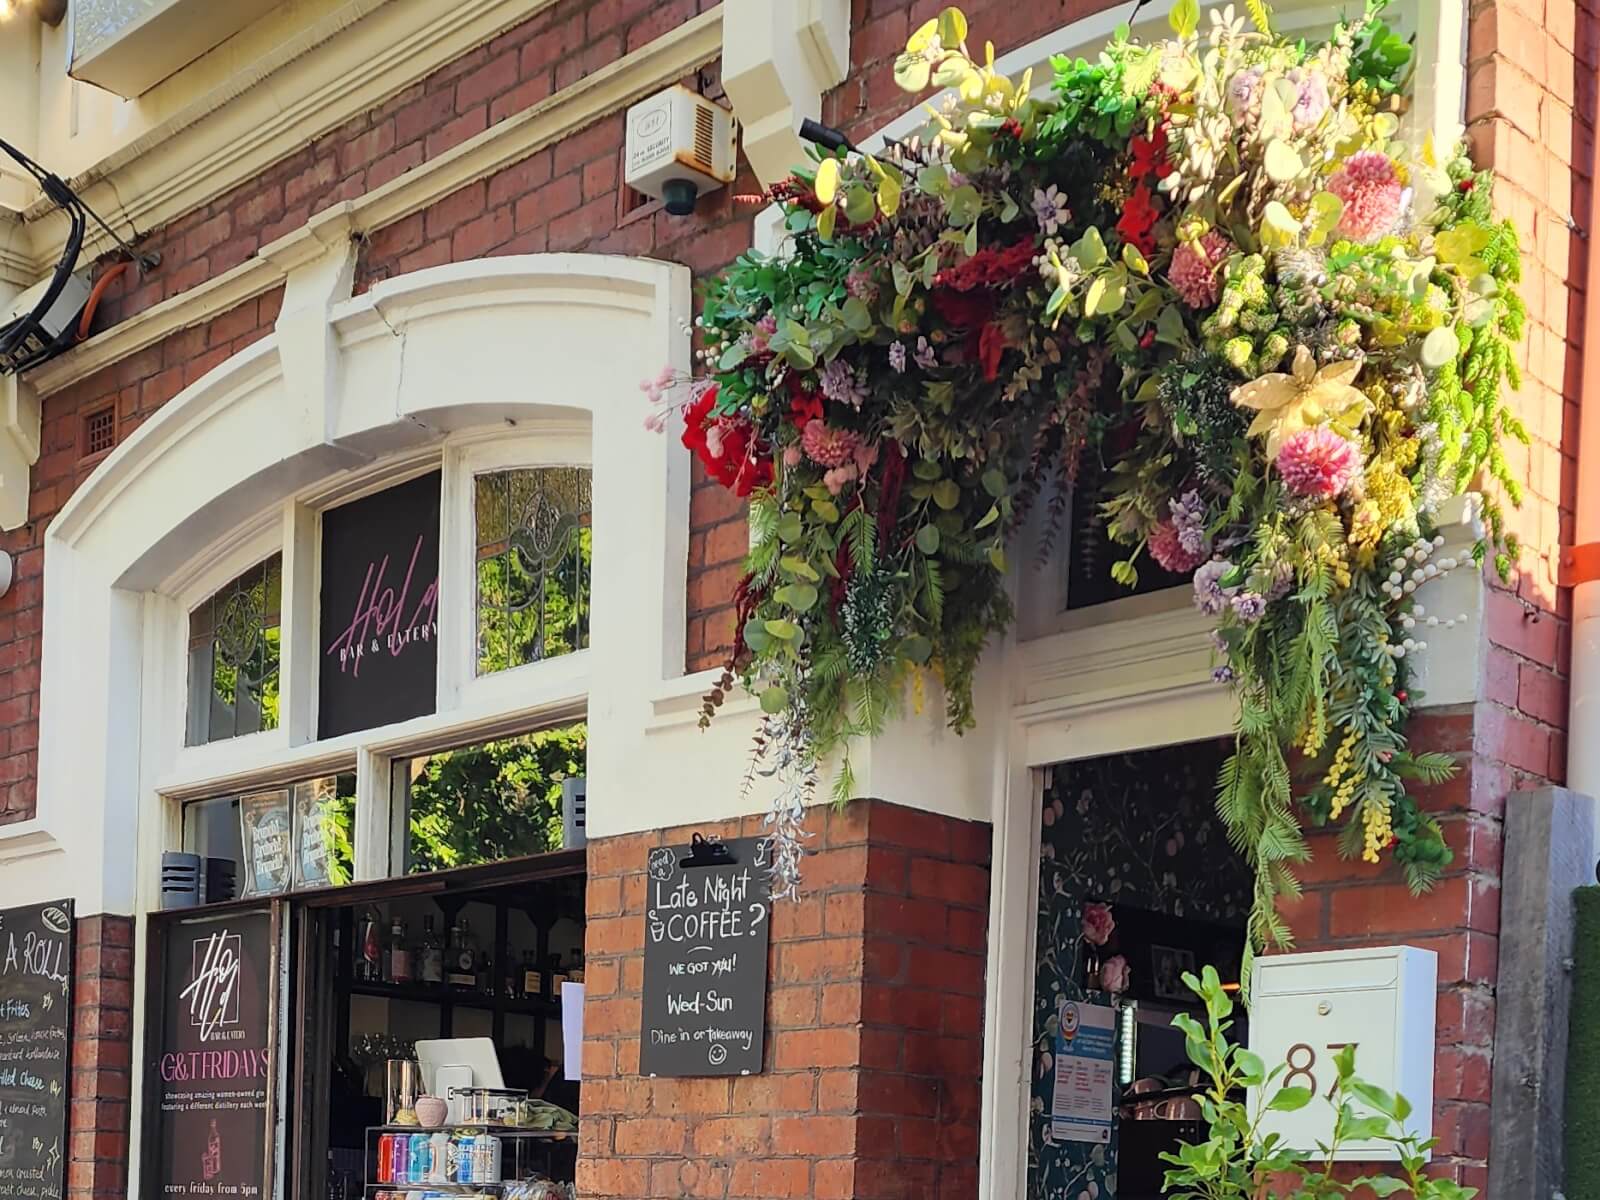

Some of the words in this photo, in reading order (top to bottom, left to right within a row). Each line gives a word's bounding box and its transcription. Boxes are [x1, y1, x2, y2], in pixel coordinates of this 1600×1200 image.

[340, 643, 365, 661] BAR
[371, 639, 380, 652] &
[656, 873, 698, 909] Late
[704, 867, 752, 912] Night
[2, 931, 18, 976] A
[669, 963, 686, 976] WE
[687, 961, 709, 975] GOT
[651, 1028, 677, 1045] Dine
[678, 1026, 691, 1041] in
[693, 1030, 705, 1040] or
[705, 1025, 753, 1051] takeaway
[160, 1051, 200, 1082] G&T
[202, 1048, 269, 1079] FRIDAYS
[1283, 1043, 1360, 1104] 87
[190, 1102, 214, 1110] different
[194, 1091, 215, 1100] amazing
[164, 1184, 186, 1195] every
[189, 1181, 214, 1195] friday
[217, 1182, 238, 1194] from
[240, 1182, 258, 1197] 5pm
